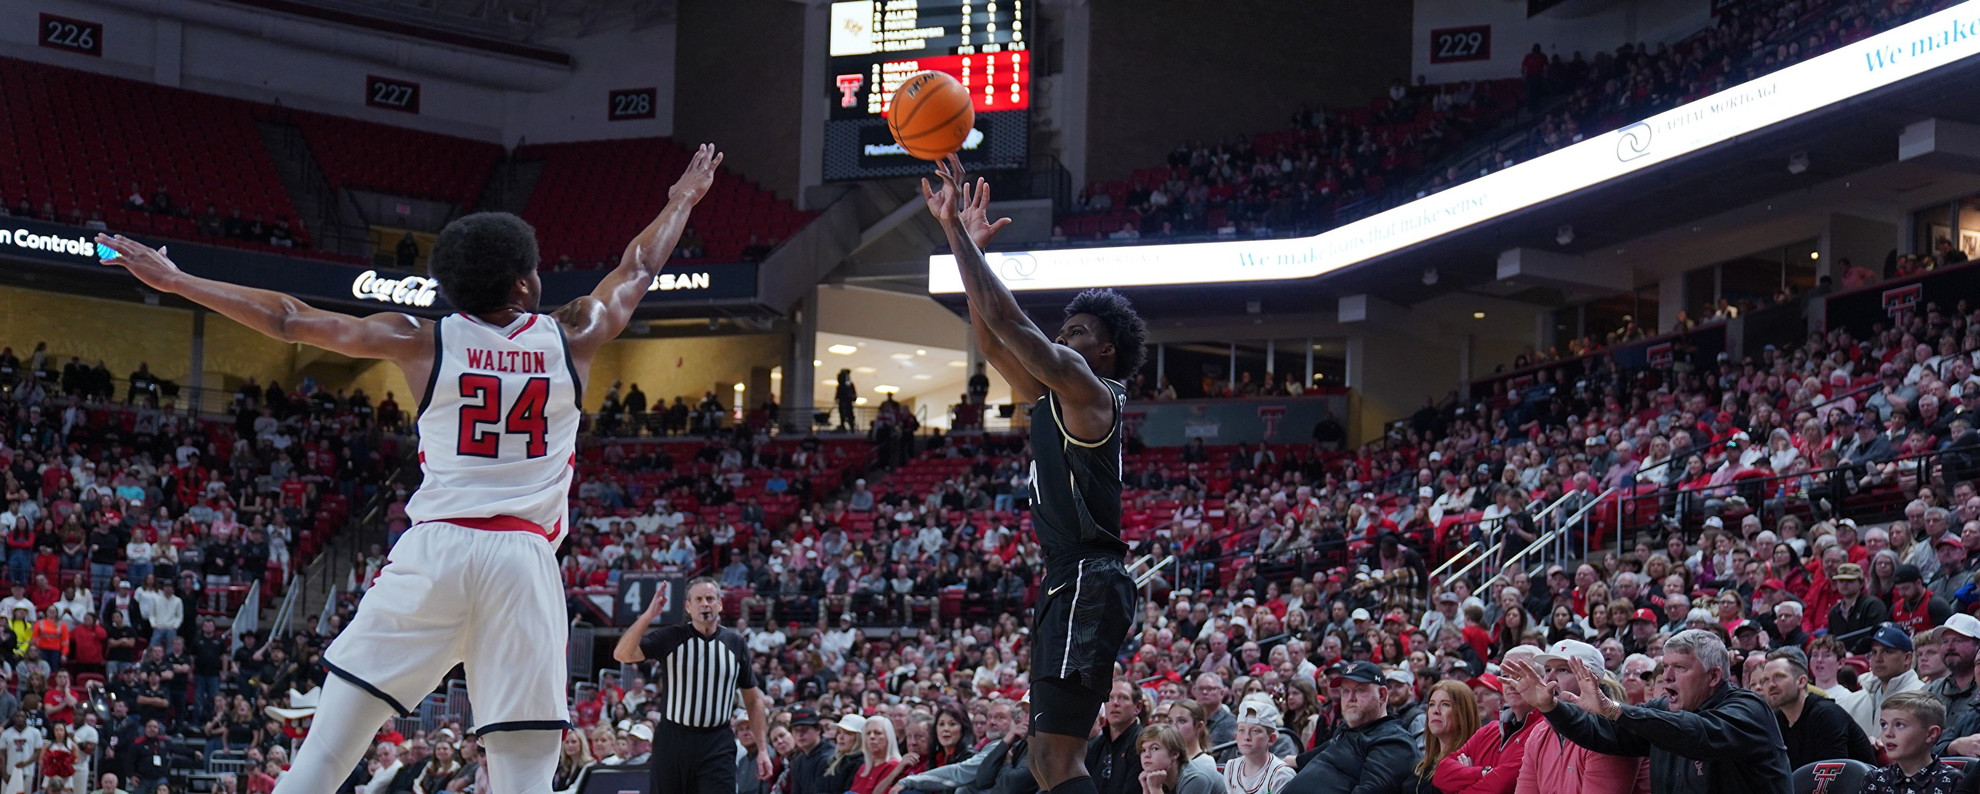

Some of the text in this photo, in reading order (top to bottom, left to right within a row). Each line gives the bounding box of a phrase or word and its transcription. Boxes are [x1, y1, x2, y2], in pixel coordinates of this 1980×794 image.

[47, 21, 93, 49] 226
[1439, 32, 1482, 57] 229
[1865, 36, 1902, 72] We
[374, 82, 413, 107] 227
[615, 93, 650, 115] 228
[14, 229, 94, 257] Controls
[466, 347, 546, 374] WALTON
[456, 372, 550, 459] 24
